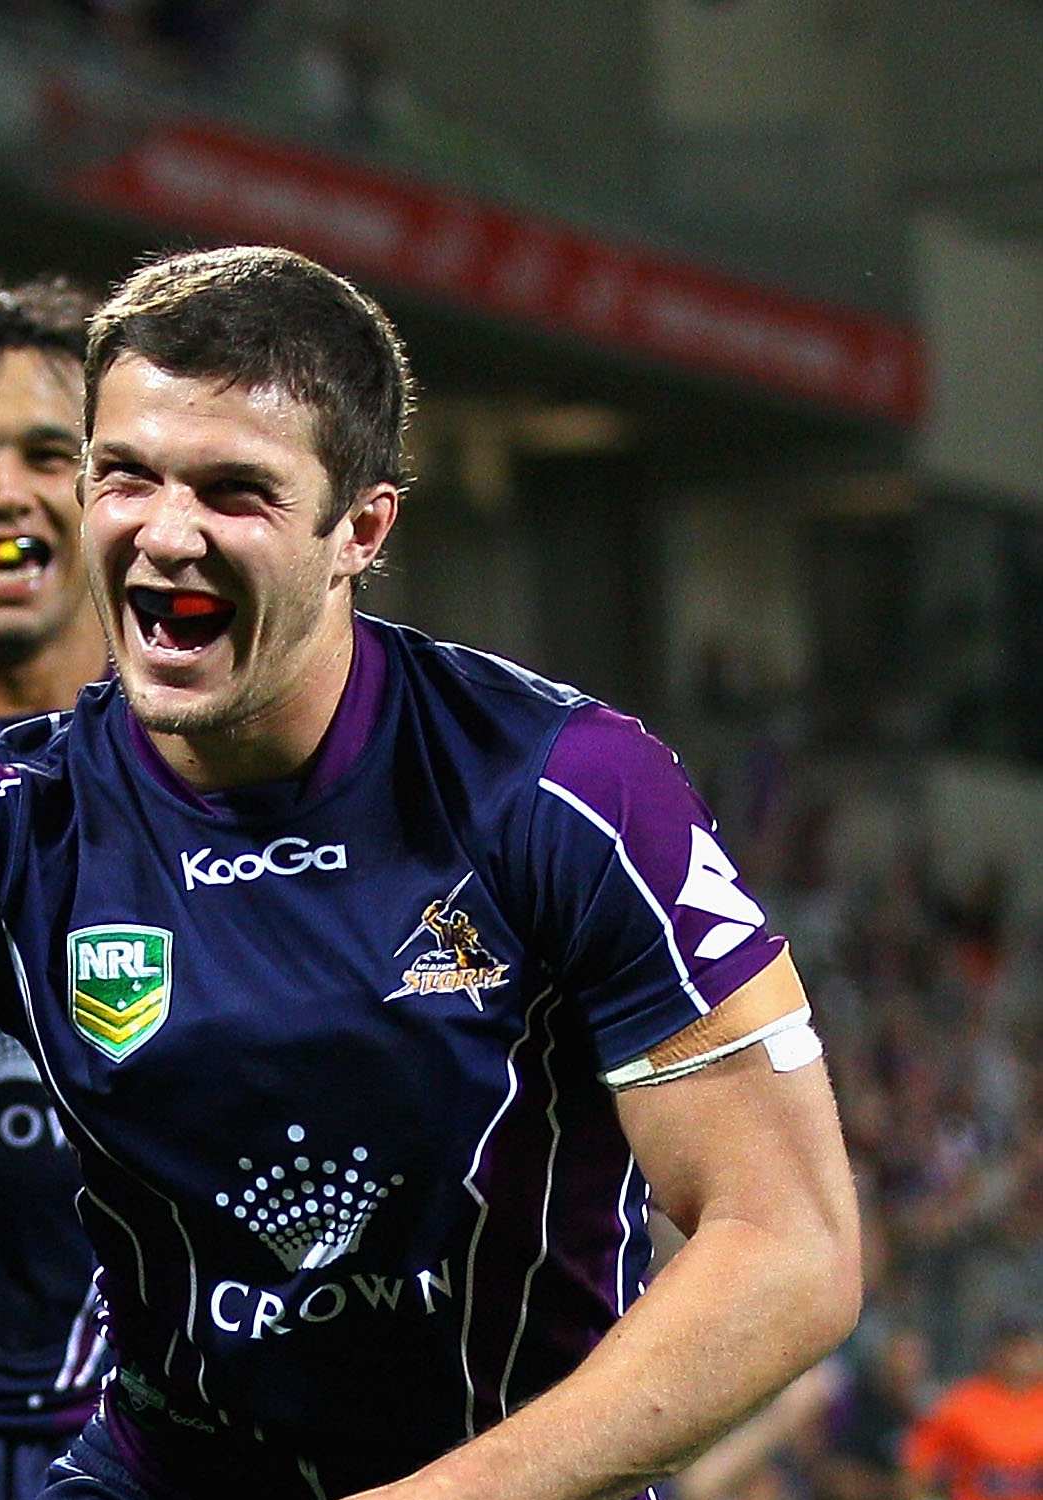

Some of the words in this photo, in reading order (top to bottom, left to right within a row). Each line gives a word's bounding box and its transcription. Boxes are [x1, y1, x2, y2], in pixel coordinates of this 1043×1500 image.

[179, 836, 348, 891] KooGa
[76, 940, 162, 982] NRL
[389, 965, 510, 1003] STORM
[209, 1257, 453, 1340] CROWN
